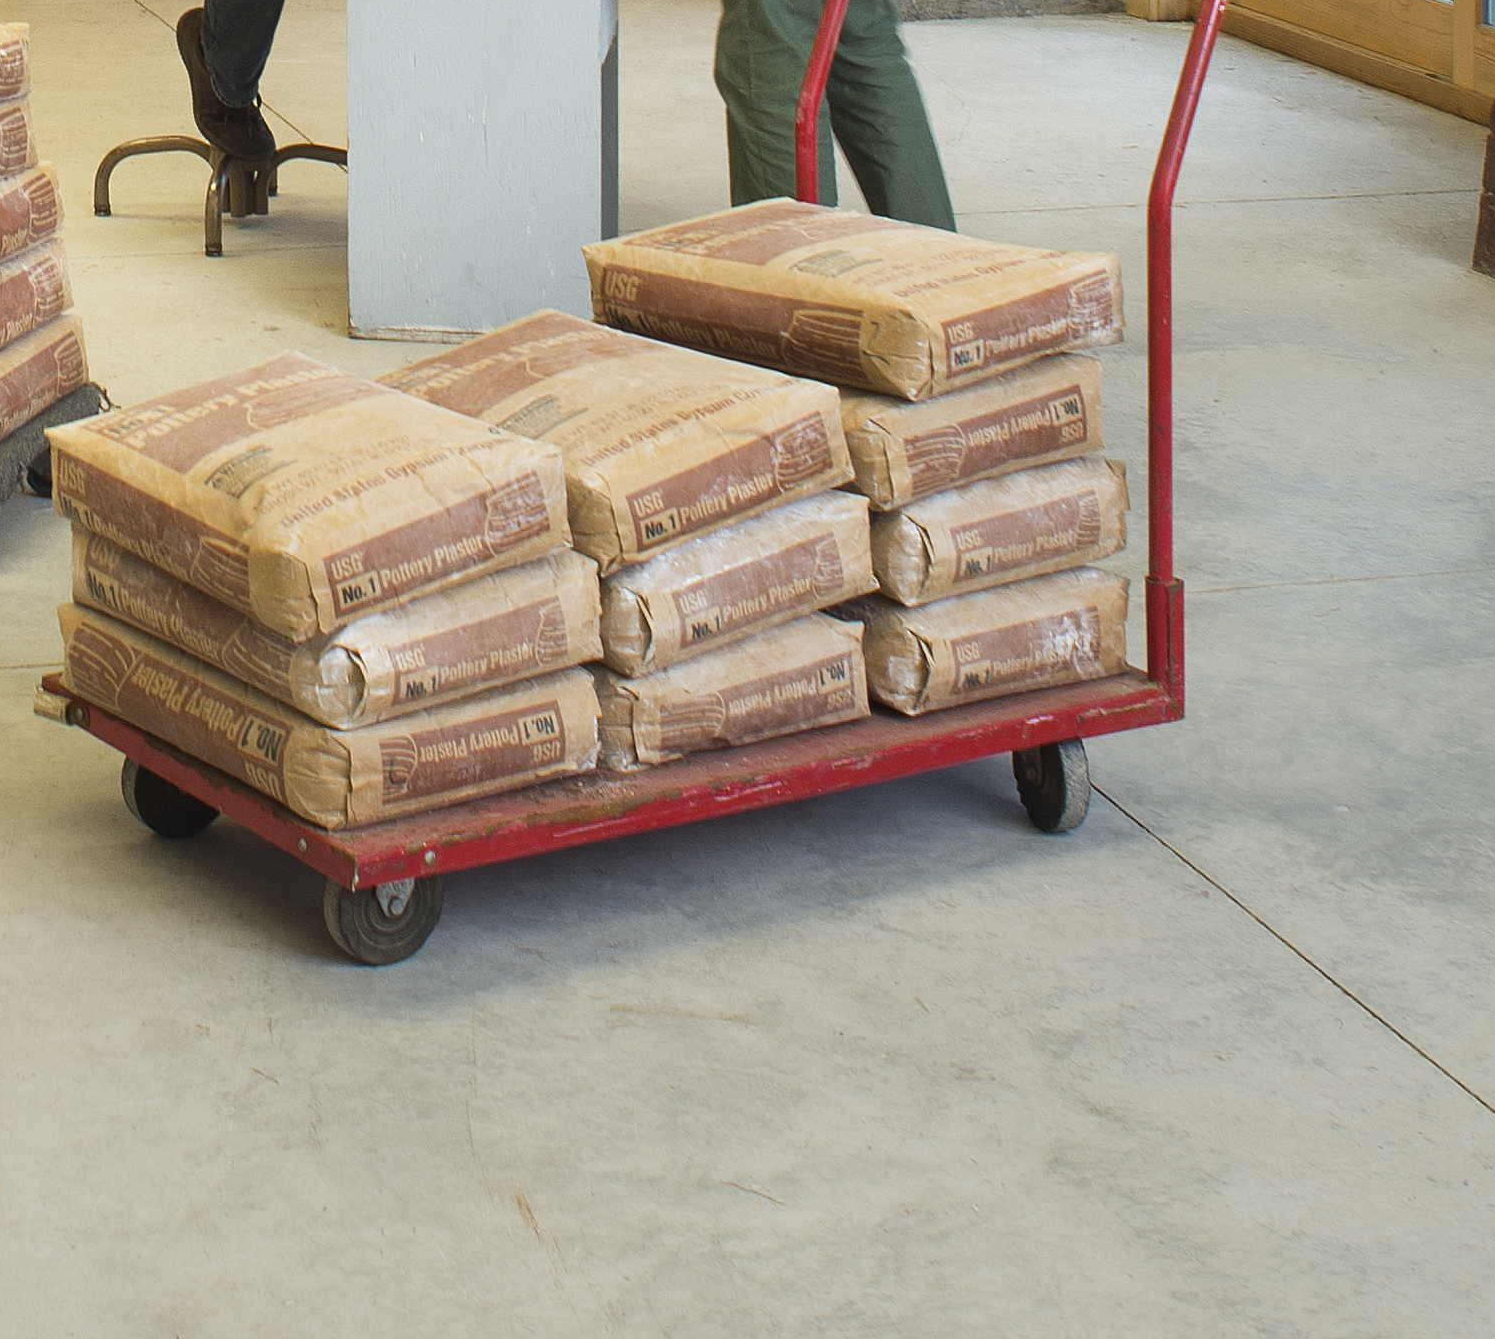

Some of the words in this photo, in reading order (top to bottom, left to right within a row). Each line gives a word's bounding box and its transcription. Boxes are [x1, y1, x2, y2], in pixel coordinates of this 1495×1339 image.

[605, 272, 640, 301] USG
[947, 322, 973, 344] USG
[986, 332, 1027, 356] Pottery
[1028, 319, 1069, 343] Plaster
[1012, 410, 1052, 434] Pottery
[1062, 423, 1083, 442] USG
[968, 425, 1010, 447] Plaster
[62, 458, 85, 496] USG
[634, 493, 664, 517] USG
[645, 521, 668, 540] No.
[680, 493, 728, 524] Pottery
[727, 473, 773, 504] Plaster
[956, 530, 981, 550] USG
[994, 542, 1034, 562] Pottery
[331, 555, 364, 579] USG
[341, 584, 367, 604] No.
[380, 556, 434, 587] Pottery
[434, 536, 484, 567] Plaster
[680, 591, 706, 614] USG
[692, 622, 712, 639] No.
[723, 595, 767, 621] Pottery
[769, 578, 810, 605] Plaster
[396, 648, 425, 670] USG
[956, 641, 979, 661] USG
[406, 682, 427, 697] No.
[440, 658, 487, 683] Pottery
[490, 643, 533, 669] Plaster
[132, 663, 188, 712] Plaster
[774, 676, 816, 700] Pottery
[728, 691, 772, 714] Plaster
[185, 688, 245, 742] Pottery
[533, 716, 555, 734] No.
[256, 726, 282, 762] No.
[420, 738, 467, 762] Plaster
[470, 725, 519, 751] Pottery
[533, 742, 560, 763] USG
